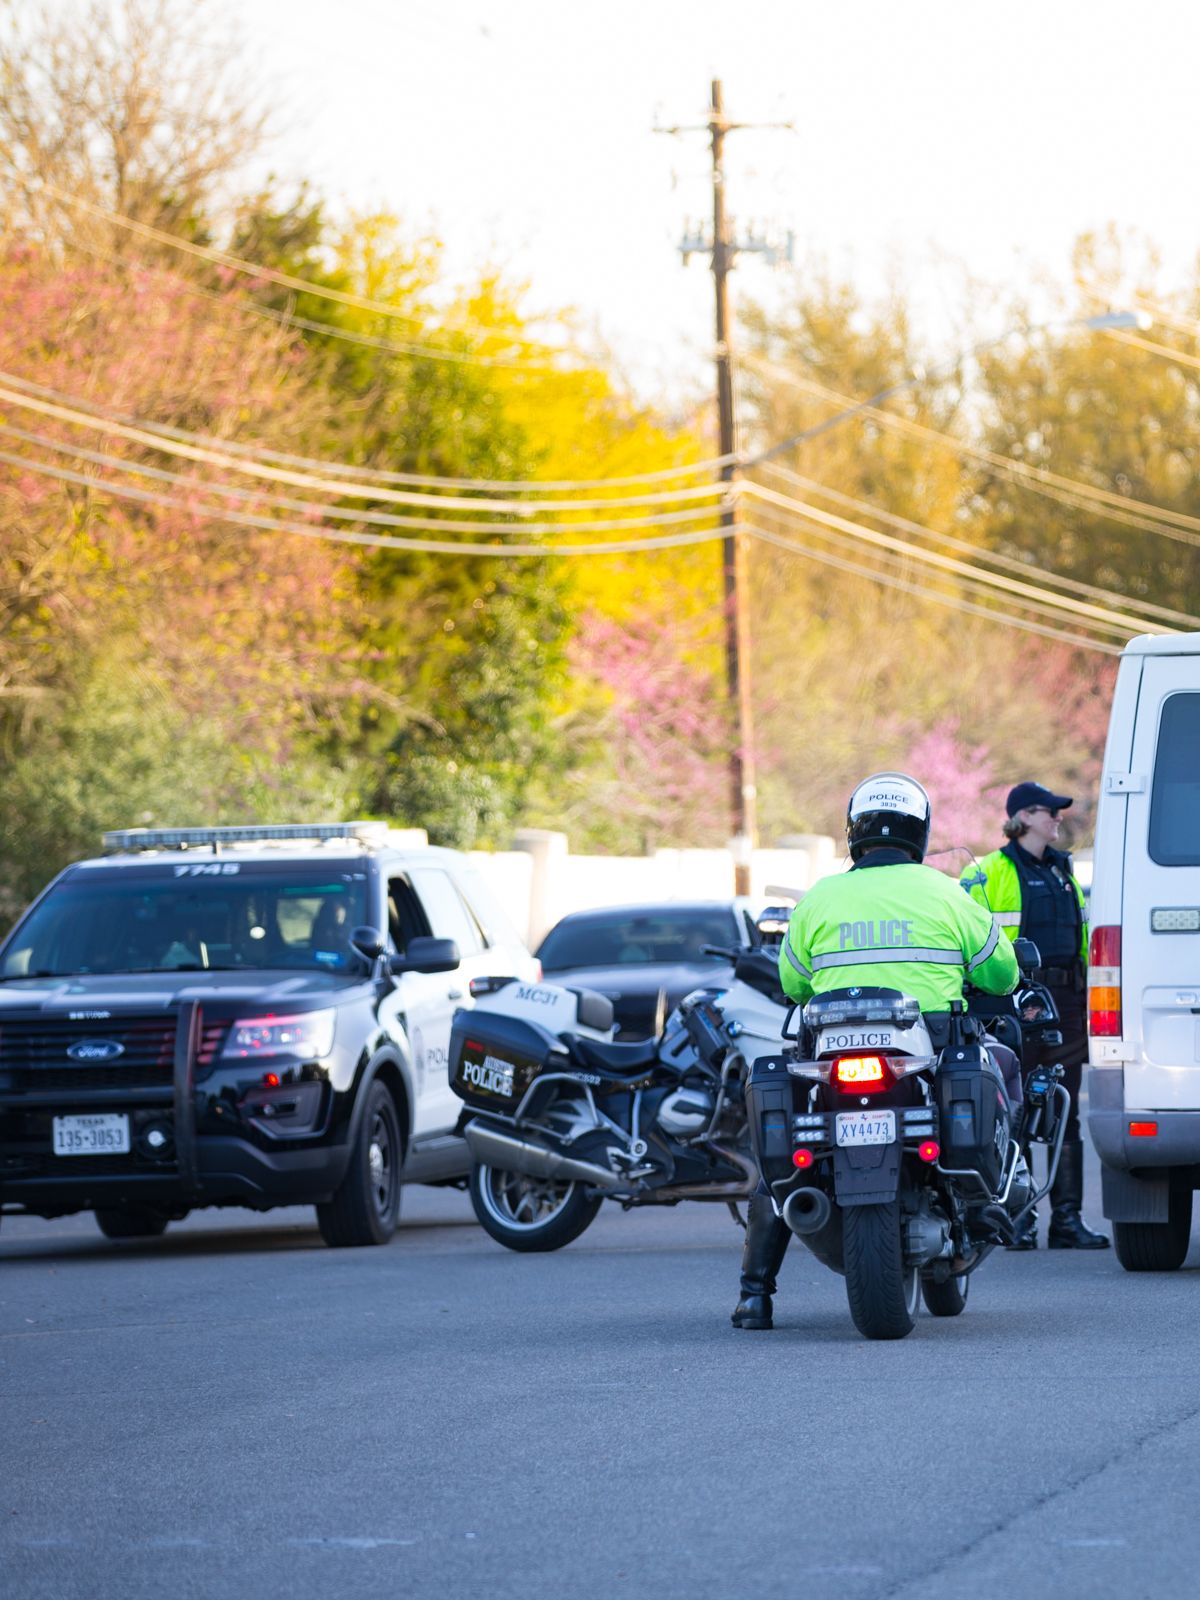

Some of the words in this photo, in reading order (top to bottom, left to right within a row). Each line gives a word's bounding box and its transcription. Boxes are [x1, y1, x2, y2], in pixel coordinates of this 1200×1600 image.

[868, 793, 910, 804] POLICE
[880, 801, 898, 809] 3839
[838, 919, 915, 950] POLICE
[825, 1032, 892, 1050] POLICE
[78, 1044, 109, 1057] Ford
[463, 1060, 513, 1097] POLICE
[841, 1122, 889, 1138] XY4473
